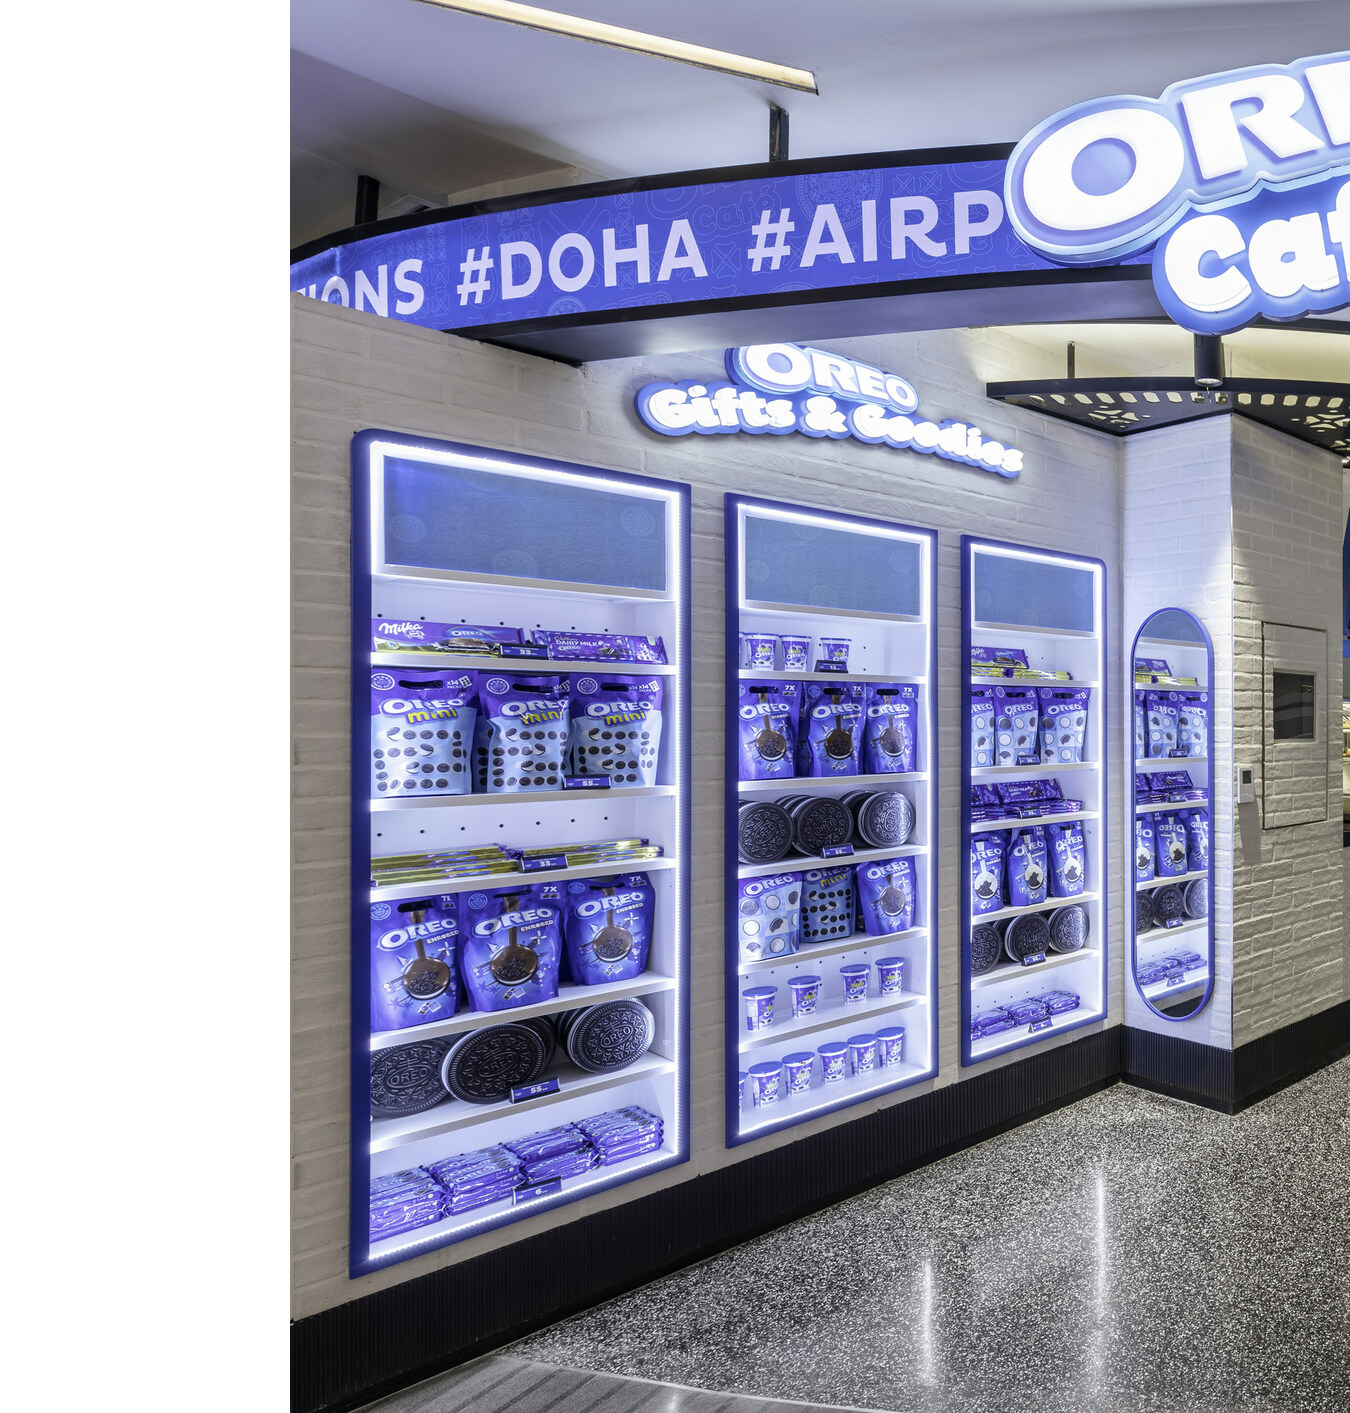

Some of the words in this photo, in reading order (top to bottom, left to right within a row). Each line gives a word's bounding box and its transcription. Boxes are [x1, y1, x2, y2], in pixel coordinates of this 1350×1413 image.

[457, 219, 708, 306] #DOHA
[747, 189, 1004, 271] #AIRP
[745, 343, 917, 407] OREO
[649, 384, 796, 429] Gifts
[805, 395, 848, 433] &
[852, 404, 1023, 473] Goodies
[379, 622, 423, 635] Milka
[383, 698, 465, 714] OREO
[501, 700, 568, 717] OREO
[587, 701, 652, 717] OREO
[739, 703, 790, 719] OREO
[811, 703, 861, 719] OREO
[867, 704, 909, 718] OREO
[1004, 704, 1033, 715] OREO
[1047, 703, 1082, 715] OREO
[407, 707, 458, 724] mini
[522, 709, 563, 725] mini
[604, 710, 646, 726] mini
[755, 823, 776, 843] OREO
[1013, 841, 1044, 857] OREO
[867, 860, 909, 880] OREO
[745, 874, 793, 897] OREO
[820, 872, 847, 888] mini
[577, 892, 644, 917] OREO
[616, 902, 644, 914] ENROBED
[474, 908, 553, 935] OREO
[520, 919, 554, 933] ENROBED
[381, 919, 457, 949] OREO
[426, 929, 459, 945] ENROBED
[602, 1026, 634, 1047] OREO
[390, 1066, 429, 1087] OREO
[530, 1086, 542, 1095] 55
